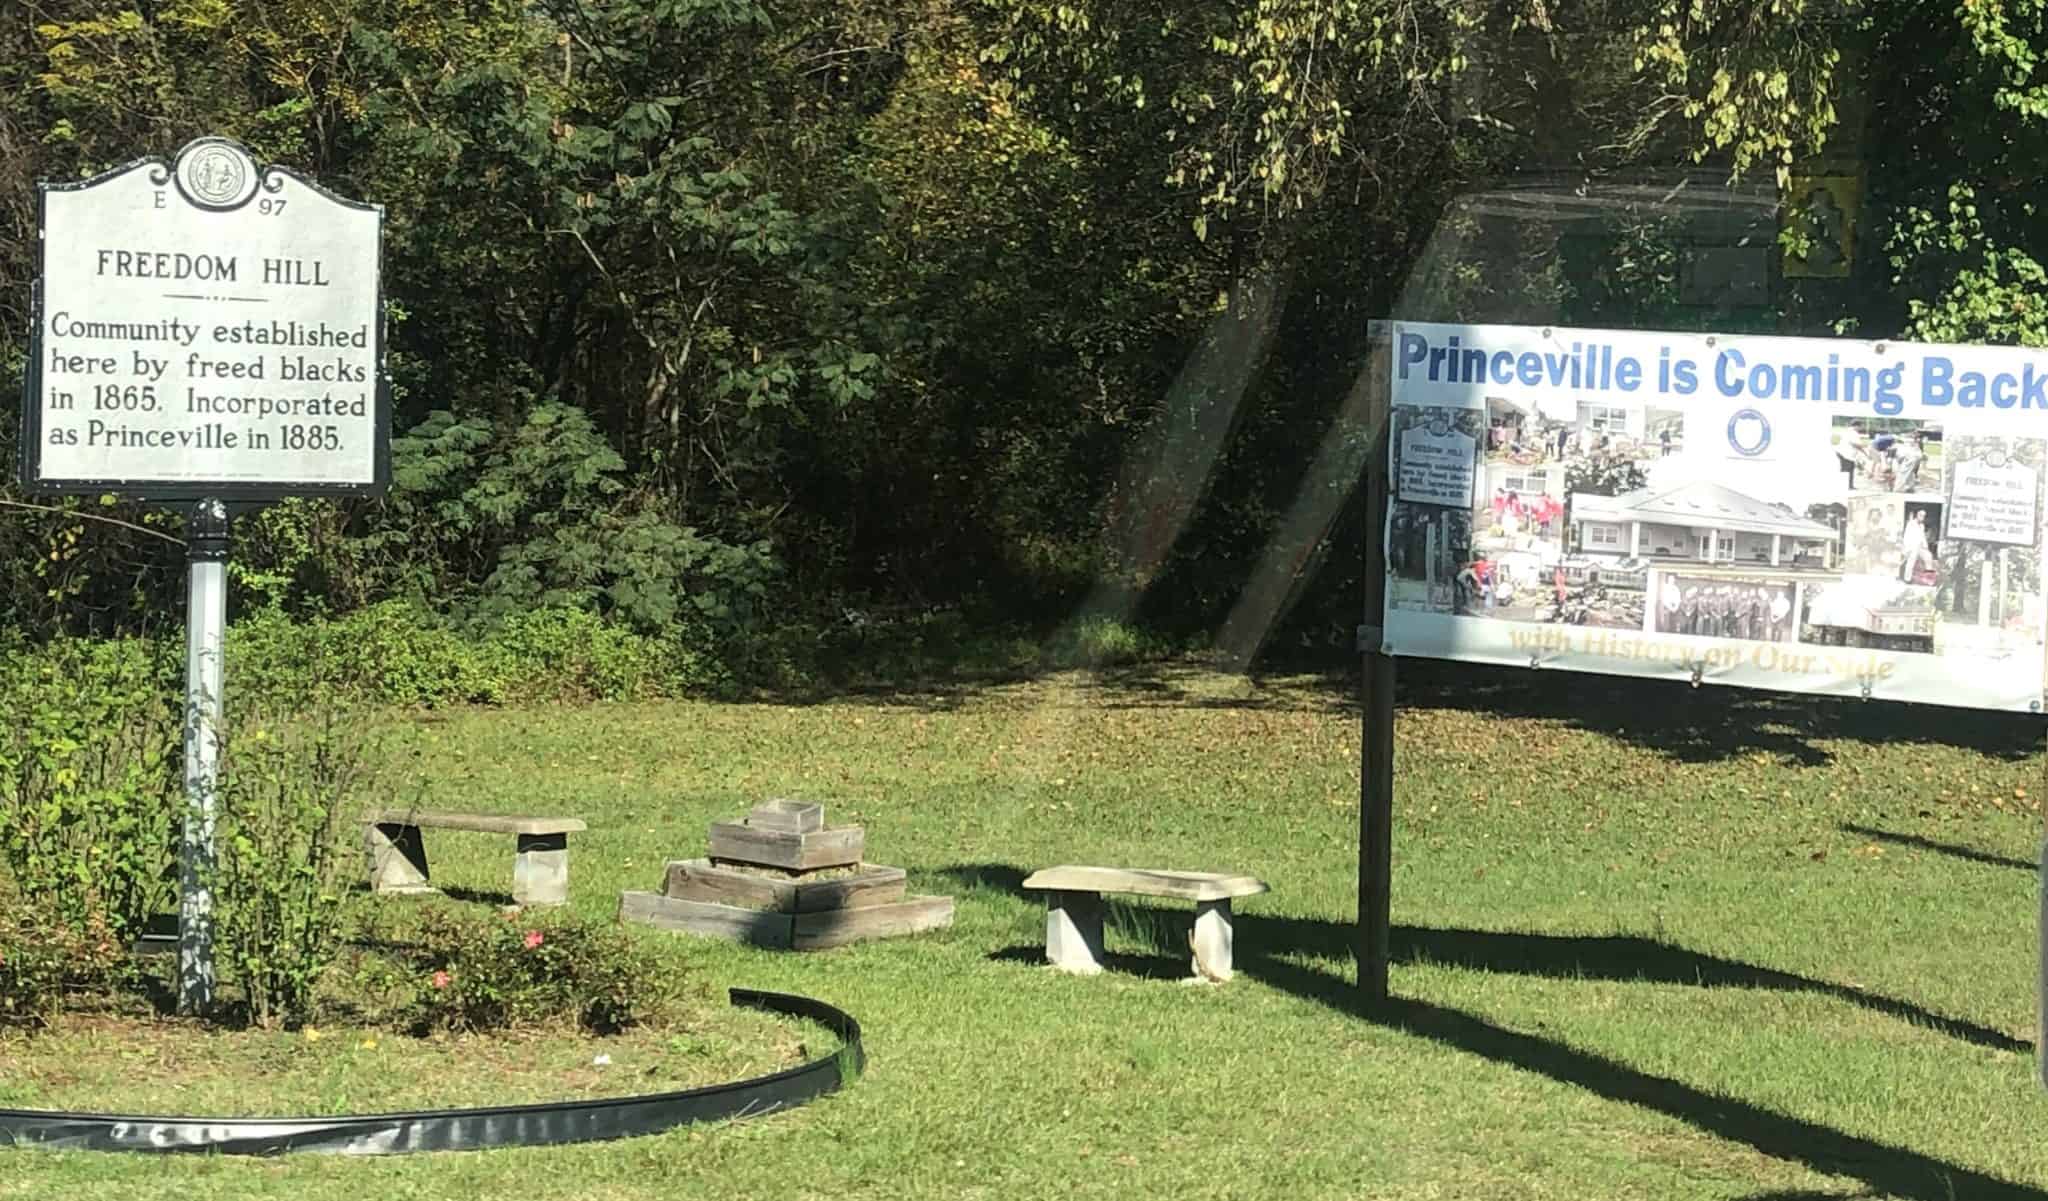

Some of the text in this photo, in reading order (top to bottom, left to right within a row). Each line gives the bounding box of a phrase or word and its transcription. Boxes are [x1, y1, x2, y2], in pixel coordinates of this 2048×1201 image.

[155, 190, 288, 216] E 97
[96, 250, 330, 286] FREEDOM HILL
[50, 311, 368, 348] Community established
[50, 348, 367, 383] here by freed blacks
[1399, 332, 2048, 416] Princeville is Coming Back
[49, 384, 367, 419] in 1865. Incorporated
[48, 419, 344, 451] as Princeville in 1885.
[1510, 626, 1572, 654] with
[1583, 631, 1697, 669] History
[1752, 641, 1818, 674] Our
